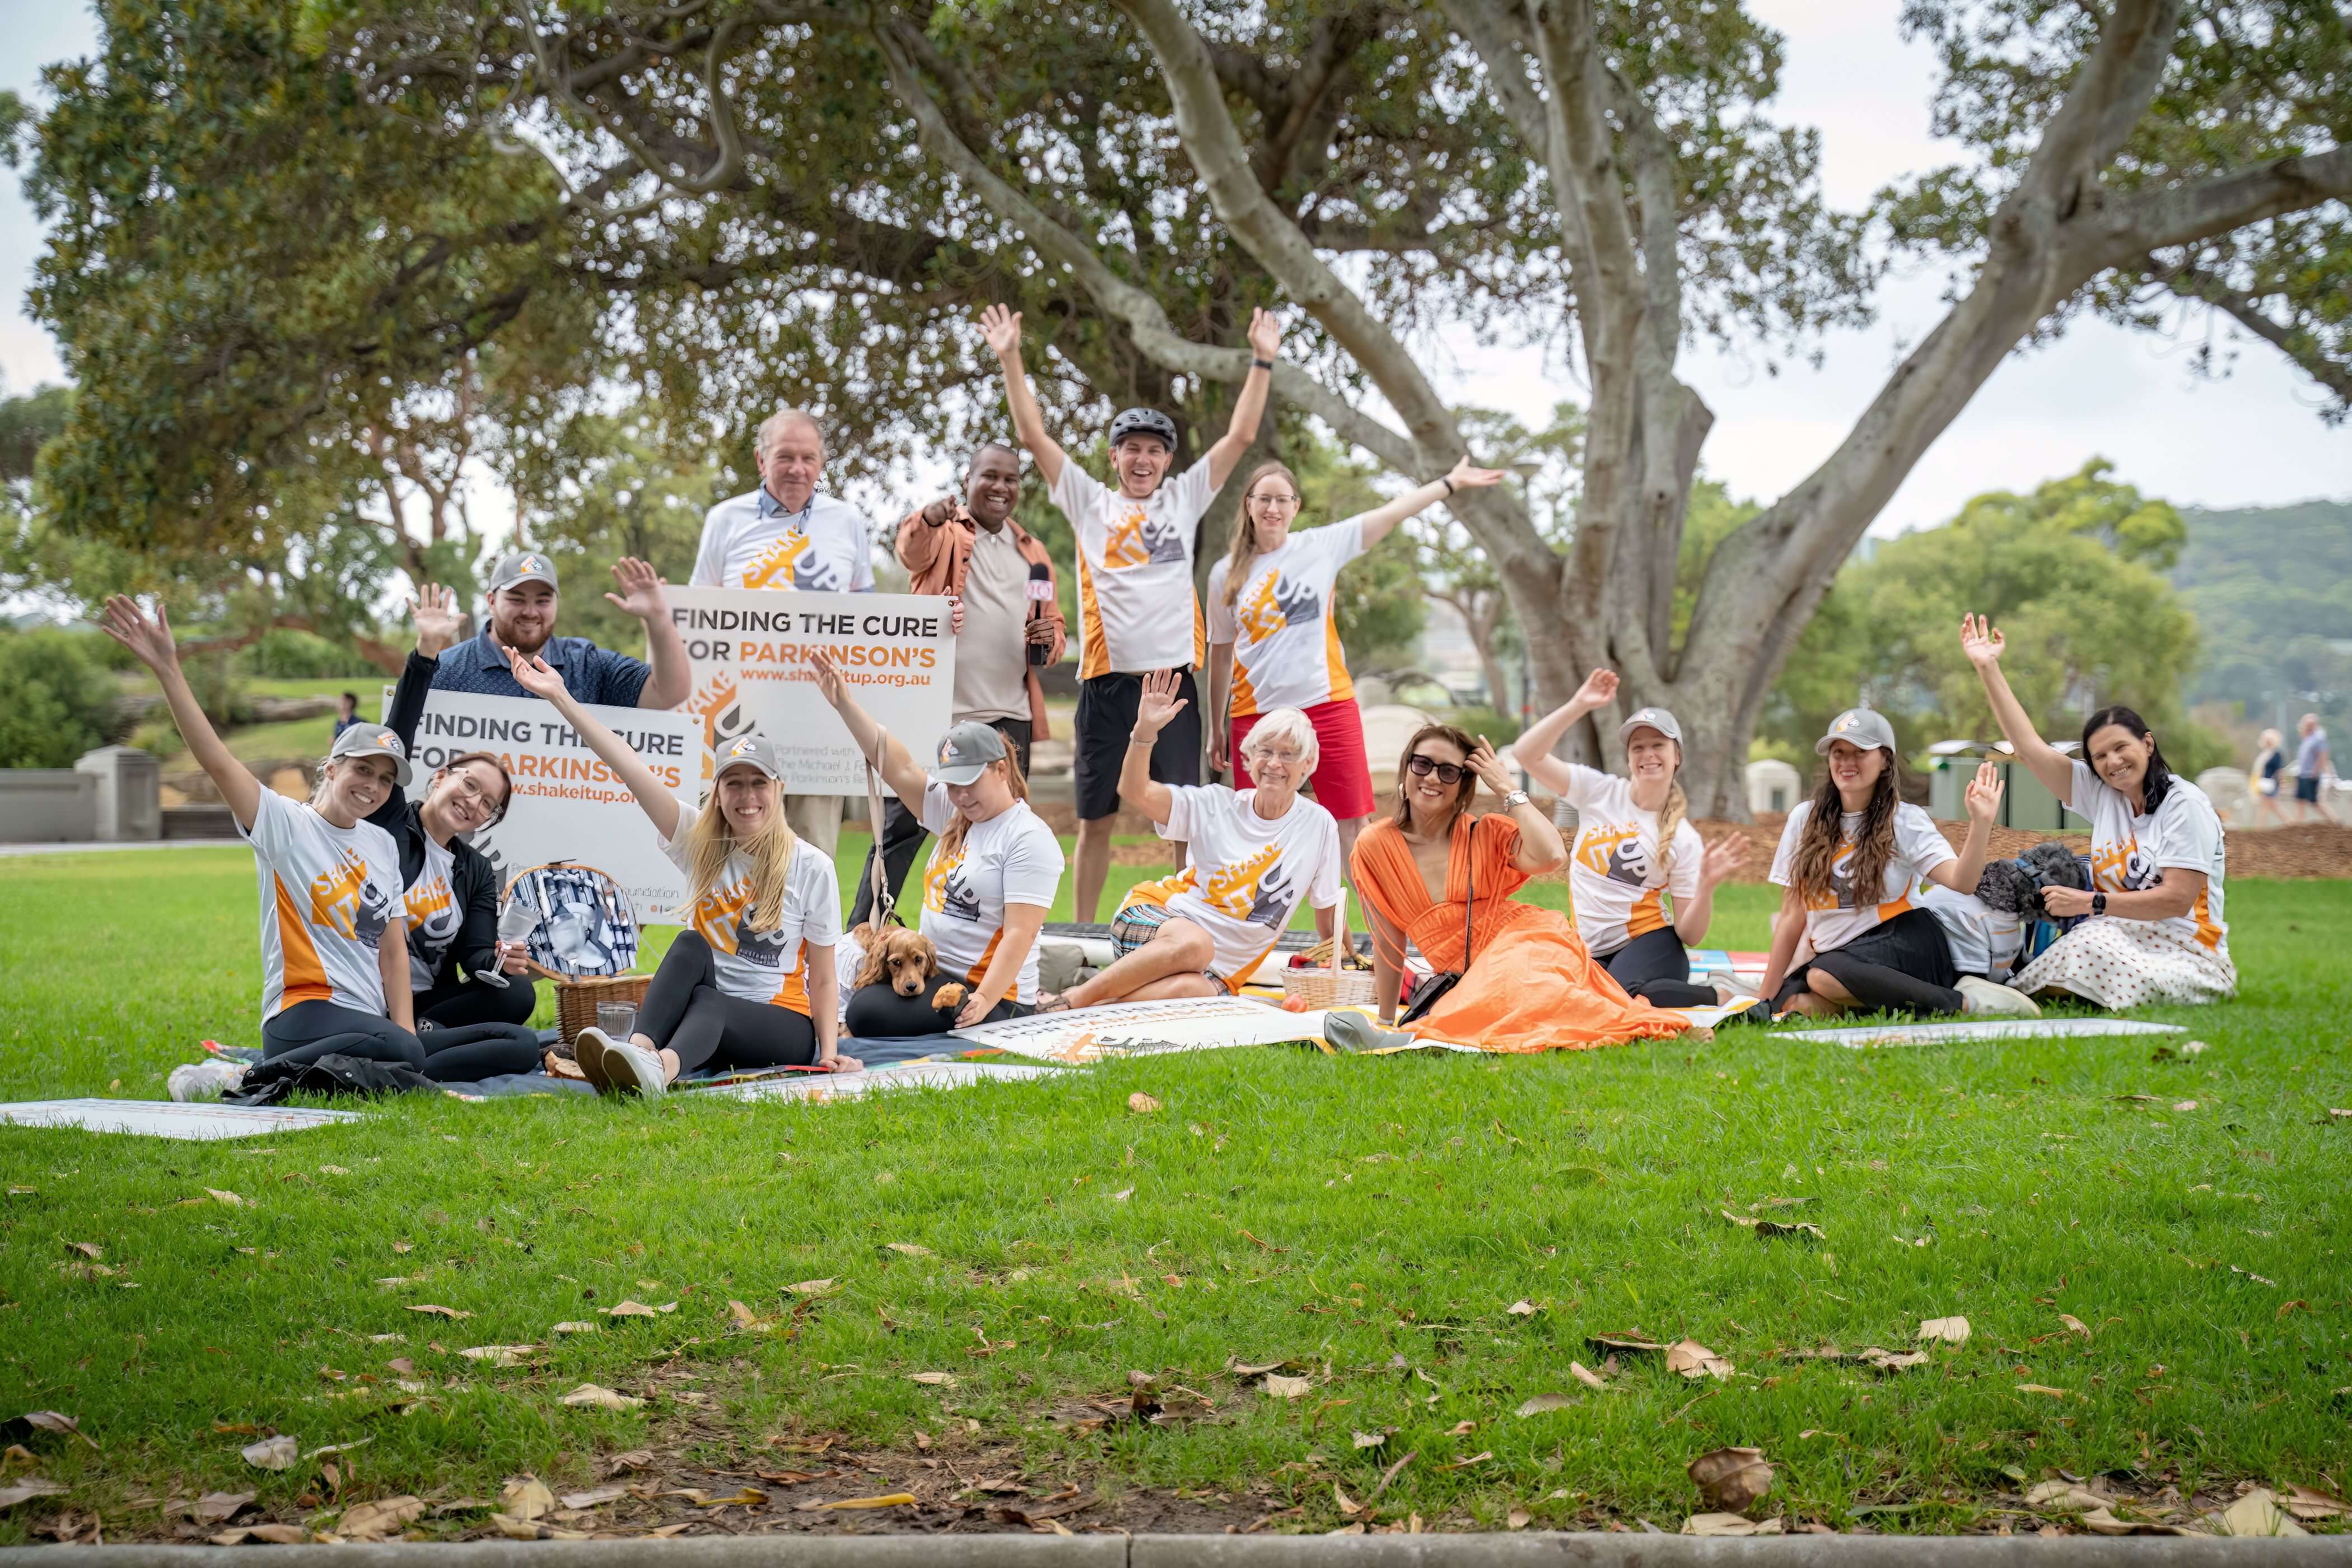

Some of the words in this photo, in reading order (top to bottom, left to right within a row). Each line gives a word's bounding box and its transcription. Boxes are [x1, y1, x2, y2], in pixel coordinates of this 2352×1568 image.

[792, 547, 841, 590] UP
[672, 607, 791, 632] FINDING
[799, 613, 855, 634] THE
[862, 615, 938, 637] CURE
[683, 639, 731, 660] OR
[739, 640, 936, 668] PARKNSON'S
[419, 713, 531, 743] INDING
[611, 729, 684, 756] URE
[1616, 838, 1649, 878] UP
[328, 893, 358, 933] IT
[706, 912, 739, 948] IT
